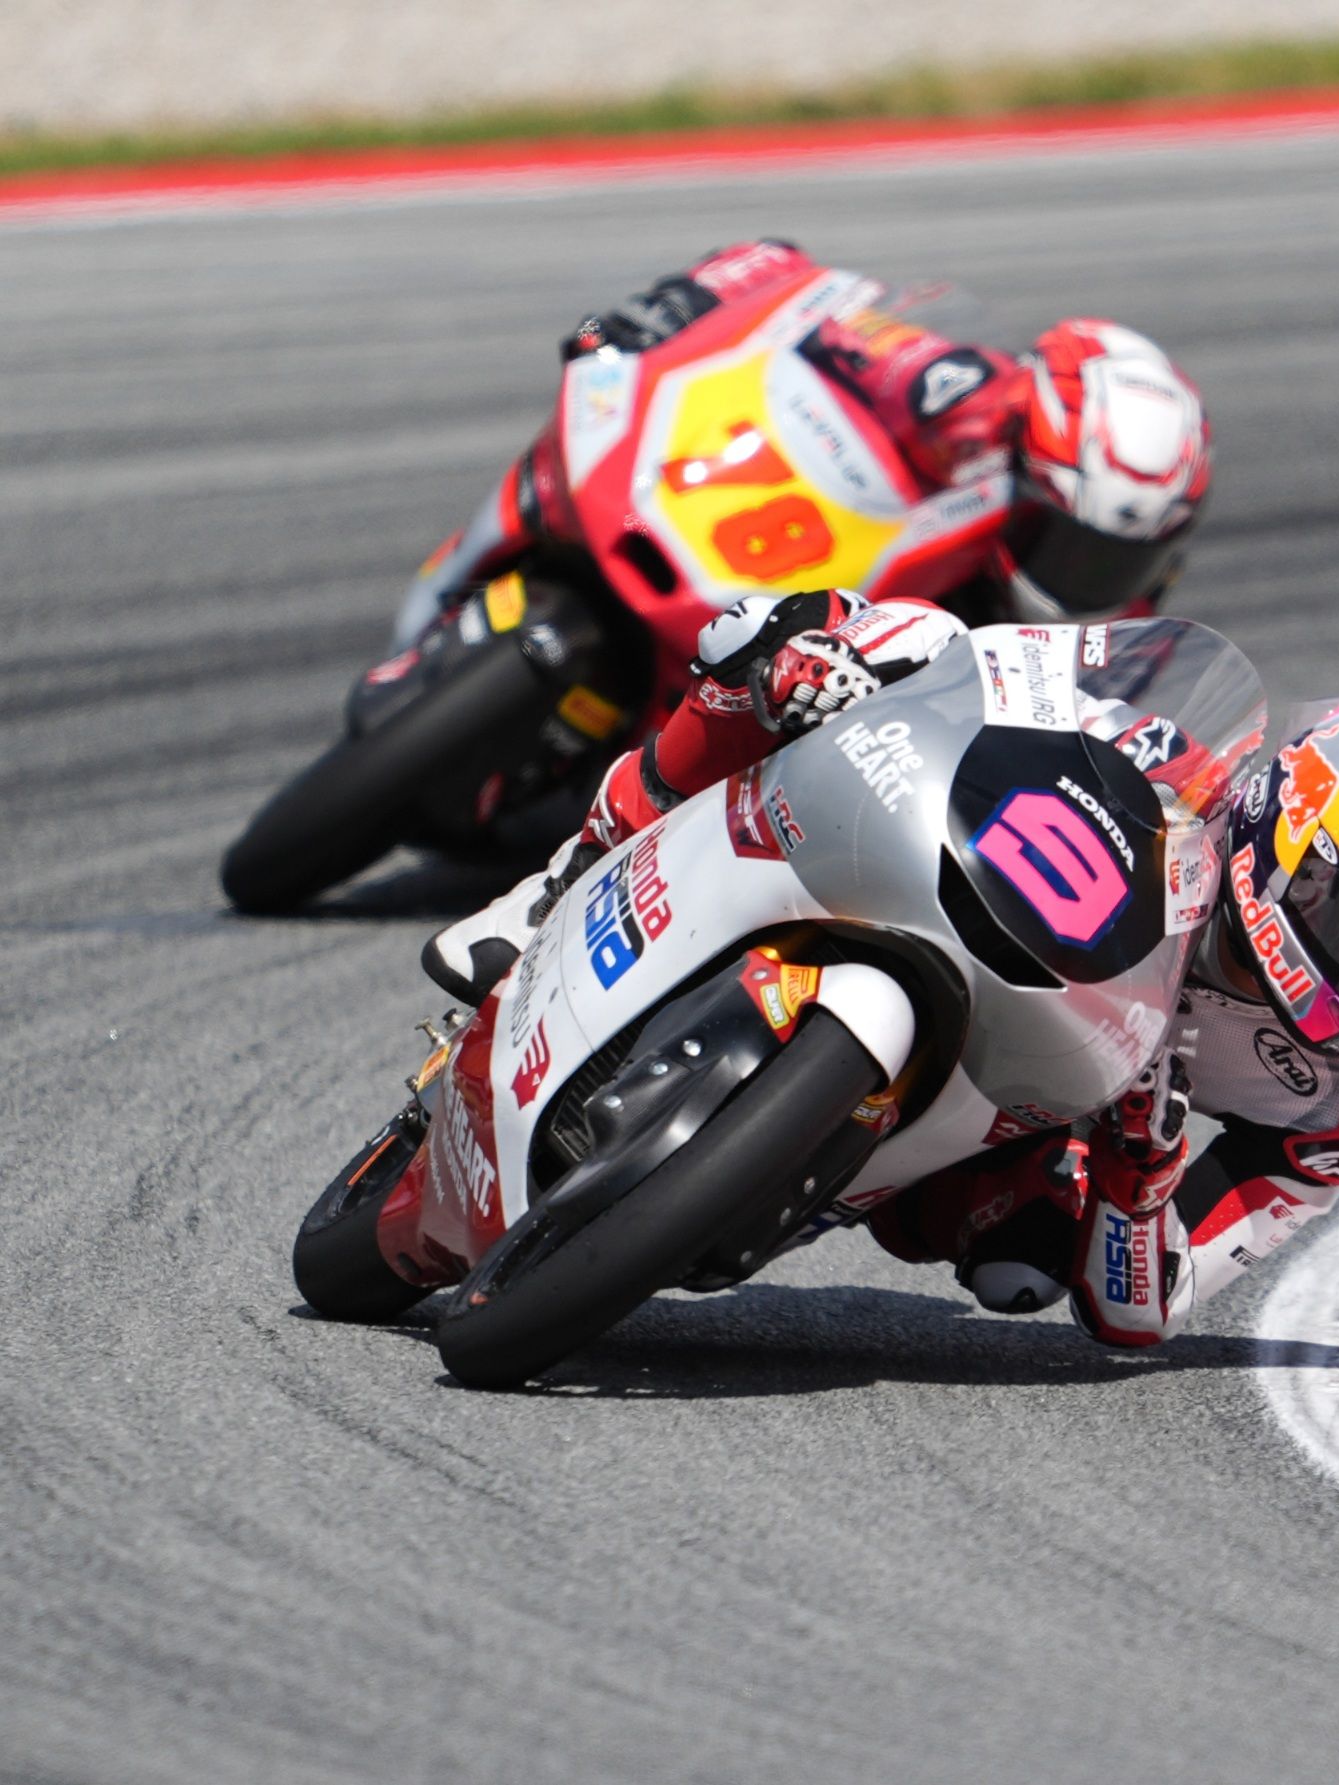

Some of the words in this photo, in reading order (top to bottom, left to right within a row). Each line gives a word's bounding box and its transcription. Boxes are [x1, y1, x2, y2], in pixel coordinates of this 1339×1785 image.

[661, 420, 836, 583] 78
[834, 721, 917, 814] HEART.
[876, 721, 925, 773] One
[1056, 775, 1134, 873] HONDA
[1258, 1036, 1316, 1088] Arai
[1132, 1220, 1151, 1306] Honda
